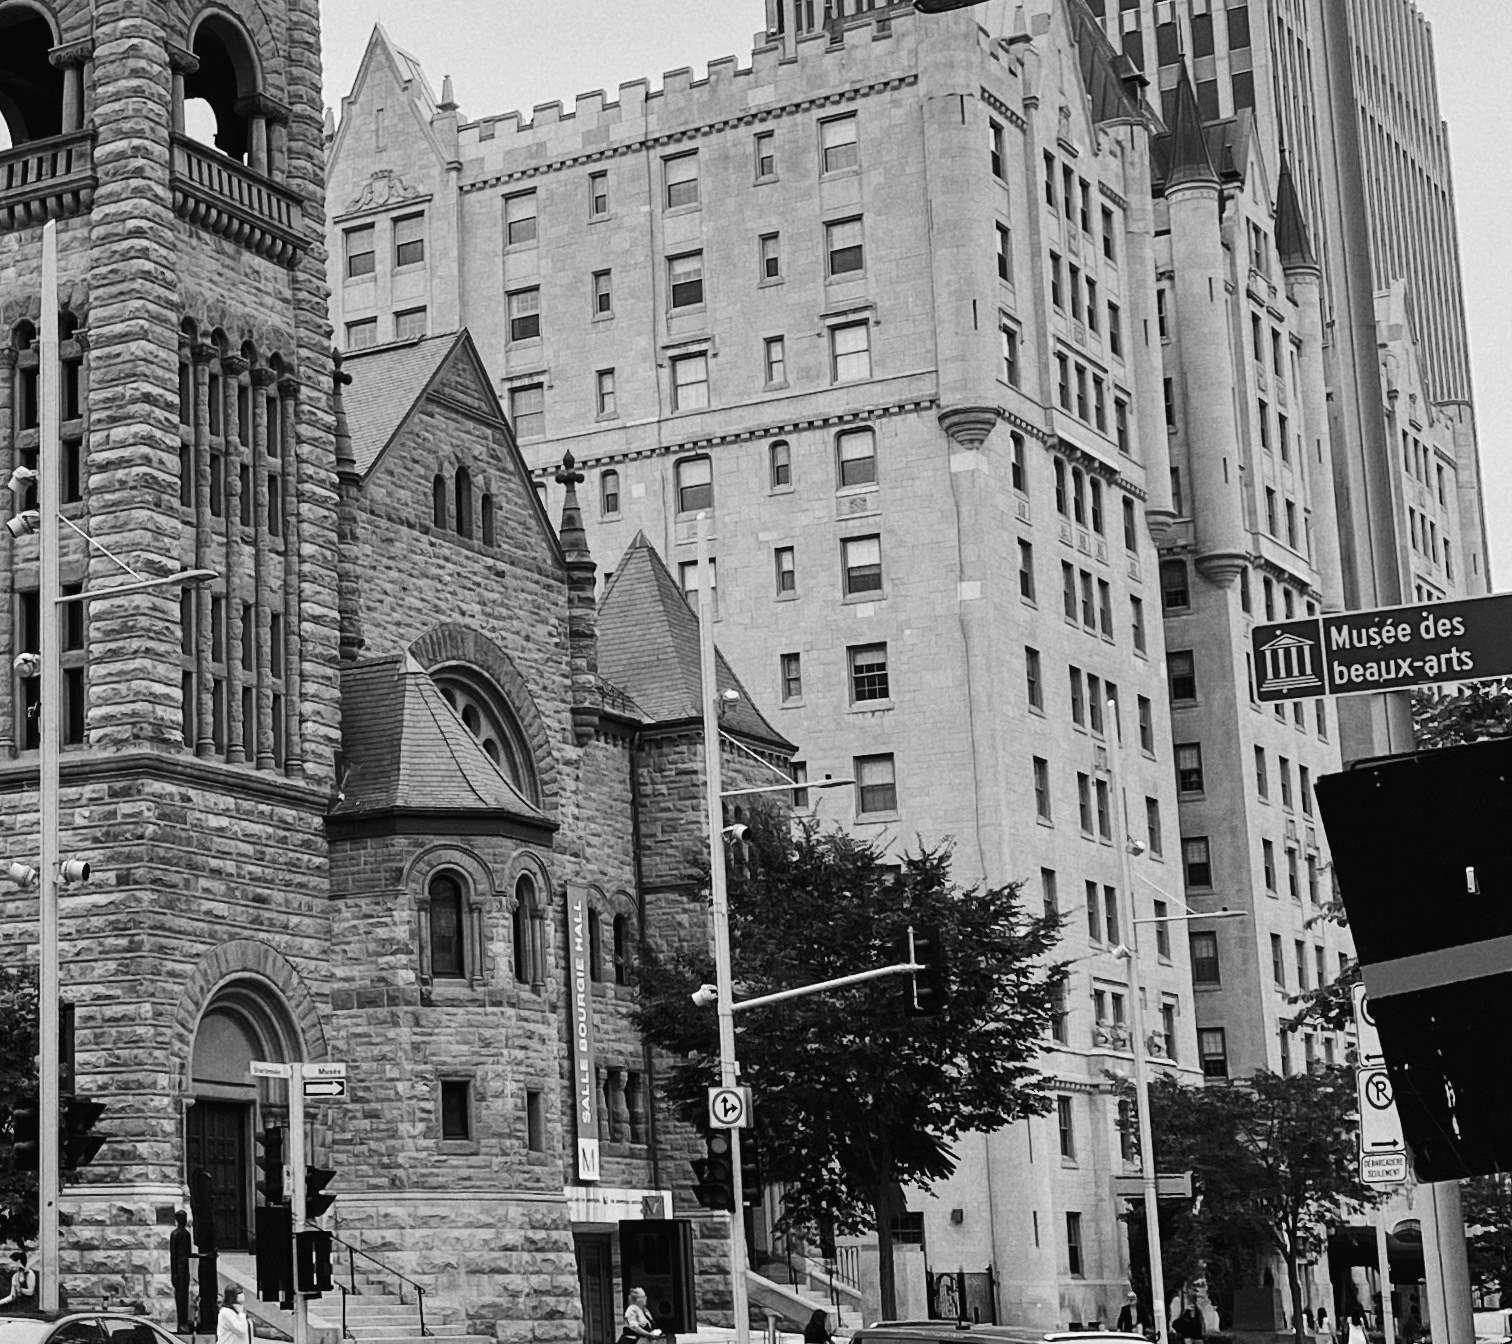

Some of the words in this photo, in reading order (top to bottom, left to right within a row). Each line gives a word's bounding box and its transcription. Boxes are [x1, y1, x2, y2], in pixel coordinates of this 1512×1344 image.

[1330, 618, 1412, 651] Musée
[1419, 613, 1465, 640] des
[1333, 646, 1474, 685] beaux-arts
[573, 899, 584, 952] HALL
[575, 958, 588, 1052] BOURGIE
[580, 1058, 591, 1124] SALLE
